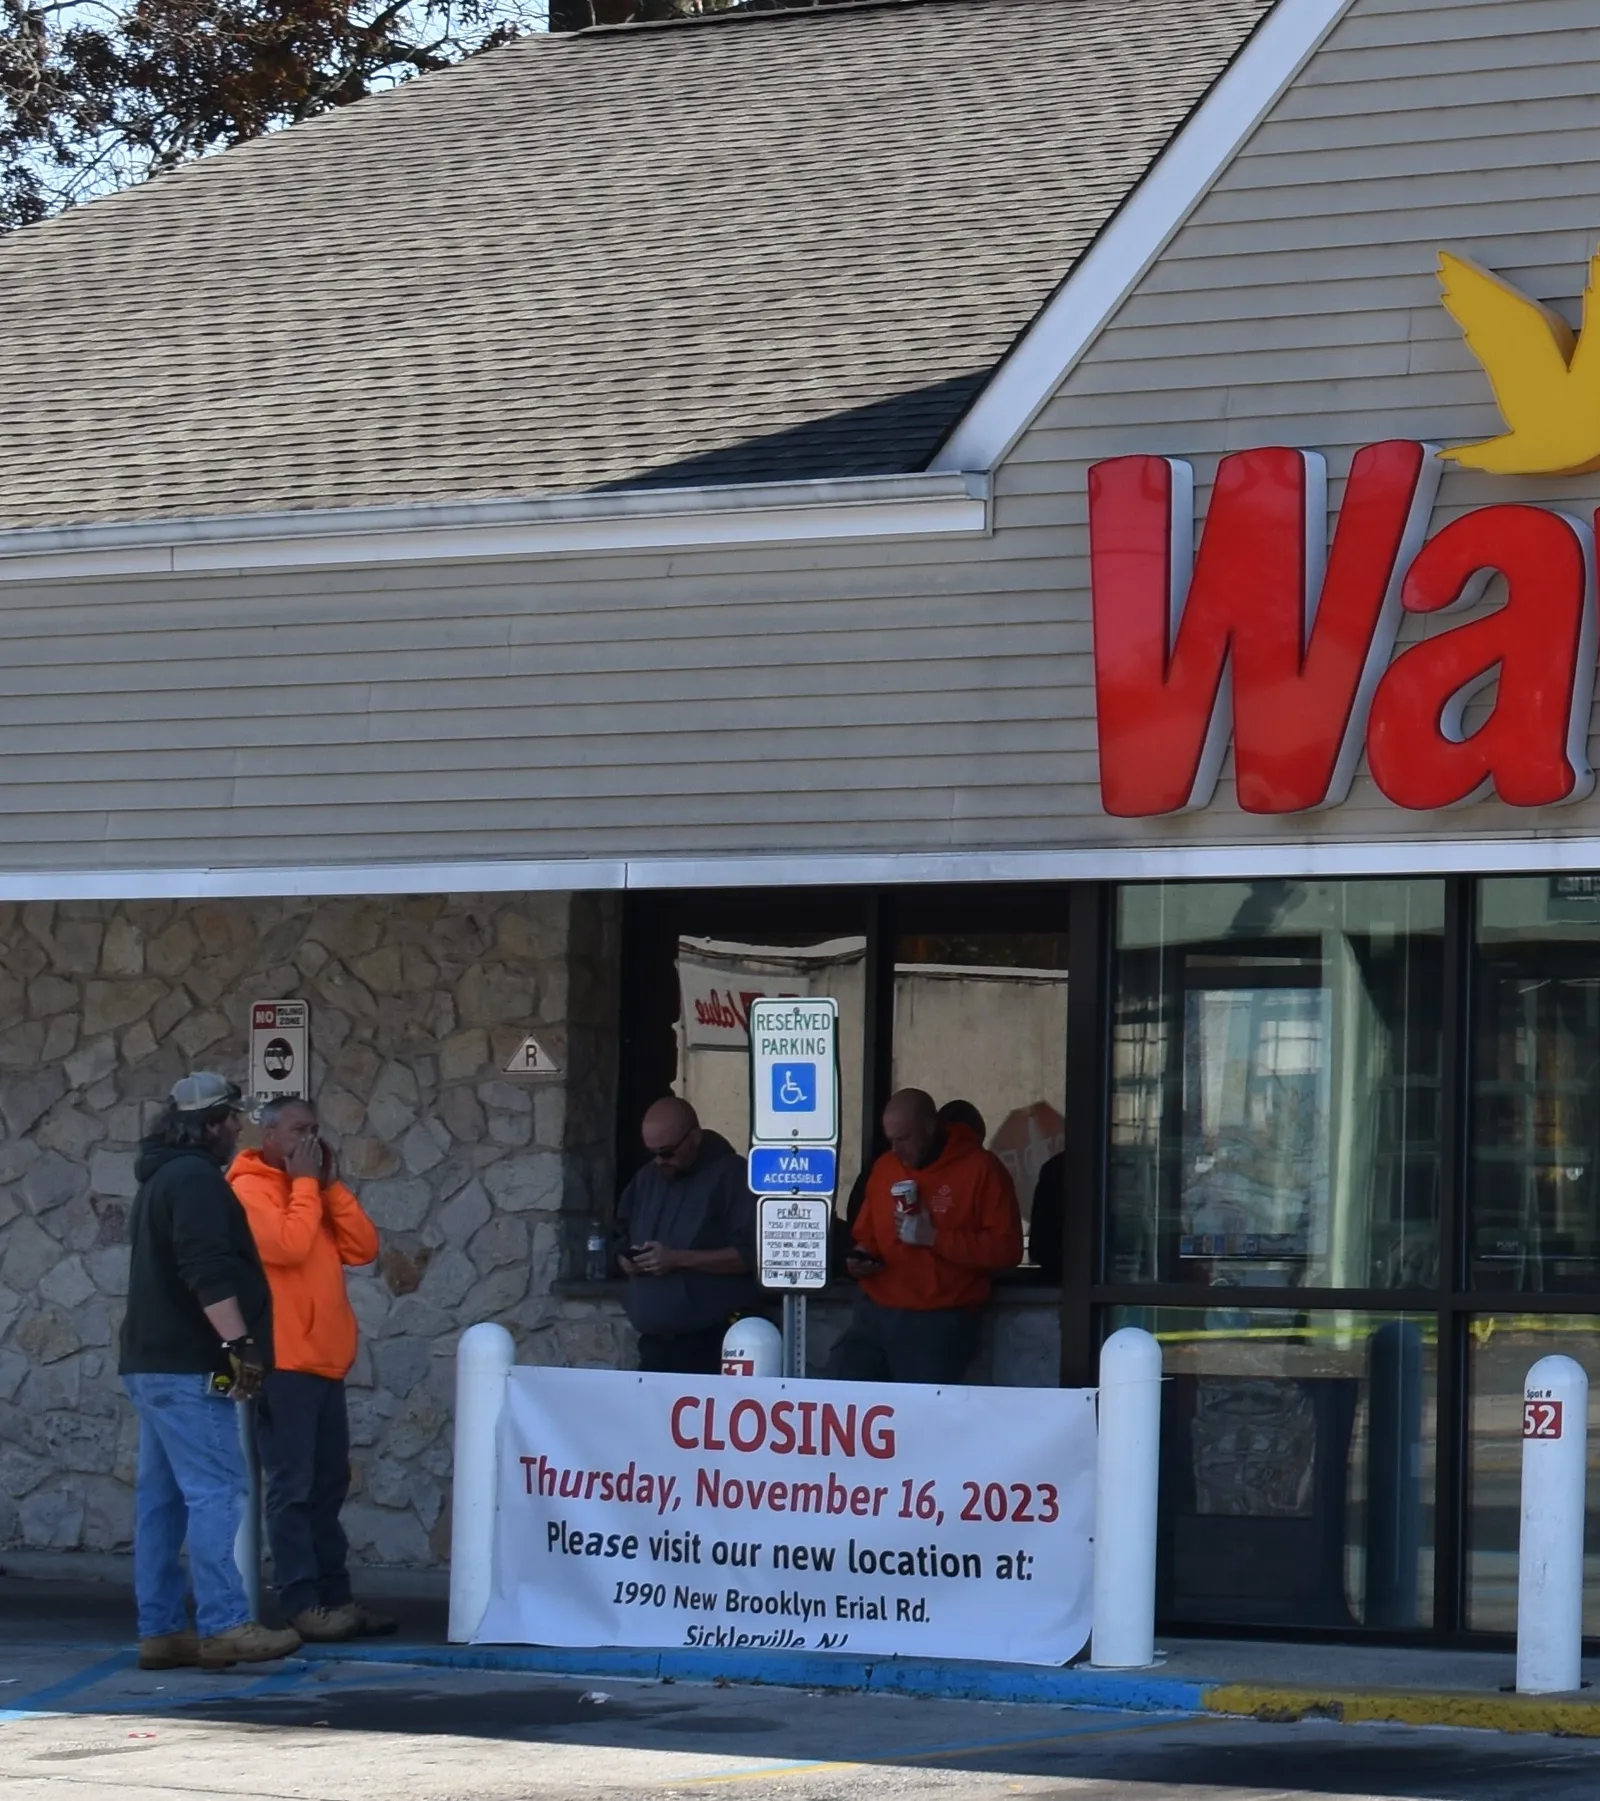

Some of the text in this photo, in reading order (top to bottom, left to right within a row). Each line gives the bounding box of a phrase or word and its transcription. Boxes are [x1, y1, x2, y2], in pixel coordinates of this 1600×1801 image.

[255, 1010, 274, 1024] NO
[279, 1016, 301, 1025] ZONE
[756, 1013, 831, 1031] RESERVED
[761, 1037, 827, 1056] PARKING
[525, 1044, 538, 1067] R
[779, 1156, 809, 1171] VAN
[763, 1173, 824, 1184] ACCESSIBLE
[777, 1208, 812, 1218] PENALTY
[793, 1221, 820, 1230] OFFENSE
[764, 1259, 798, 1267] COMMUNITY
[764, 1270, 824, 1280] TOW-AWAY ZONE
[1527, 1389, 1543, 1399] Spot
[1523, 1404, 1556, 1435] 52
[670, 1395, 896, 1460] CLOSING
[519, 1455, 1060, 1527] Thursday, November 16, 2023
[547, 1519, 1034, 1581] Please visit our new location at:
[612, 1580, 931, 1623] 1990 New Brooklyn Erial Rd.
